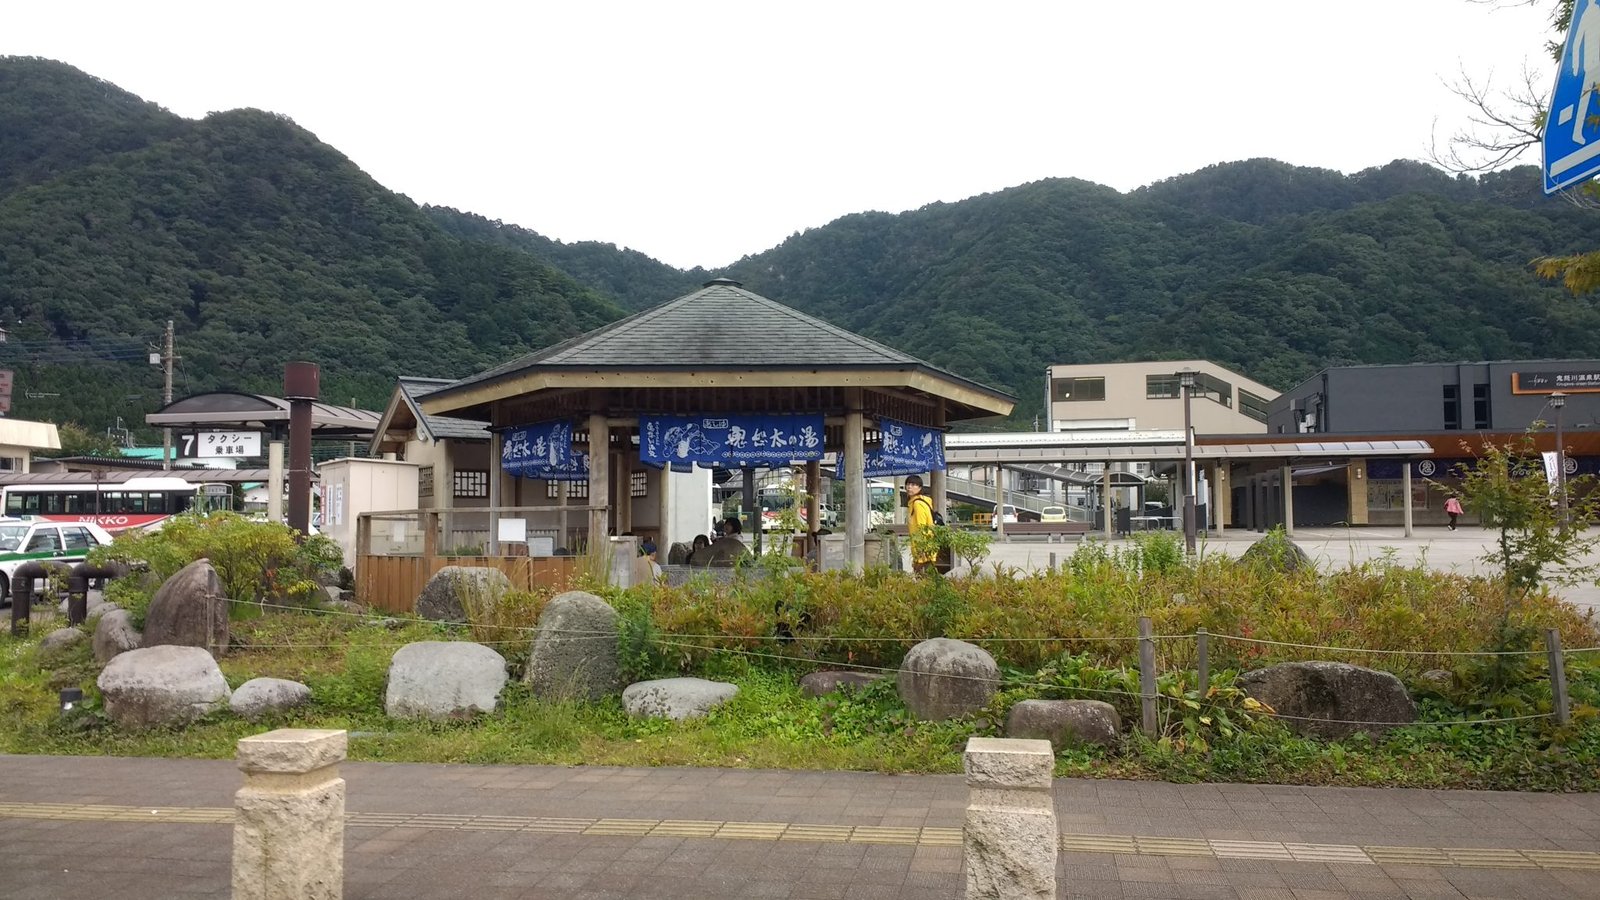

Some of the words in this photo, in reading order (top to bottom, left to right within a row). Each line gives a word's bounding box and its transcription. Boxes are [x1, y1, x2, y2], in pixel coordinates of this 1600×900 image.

[207, 434, 252, 444] タクシー
[181, 434, 195, 456] 7
[215, 445, 245, 455] 乗車場
[78, 516, 129, 525] NIKKO
